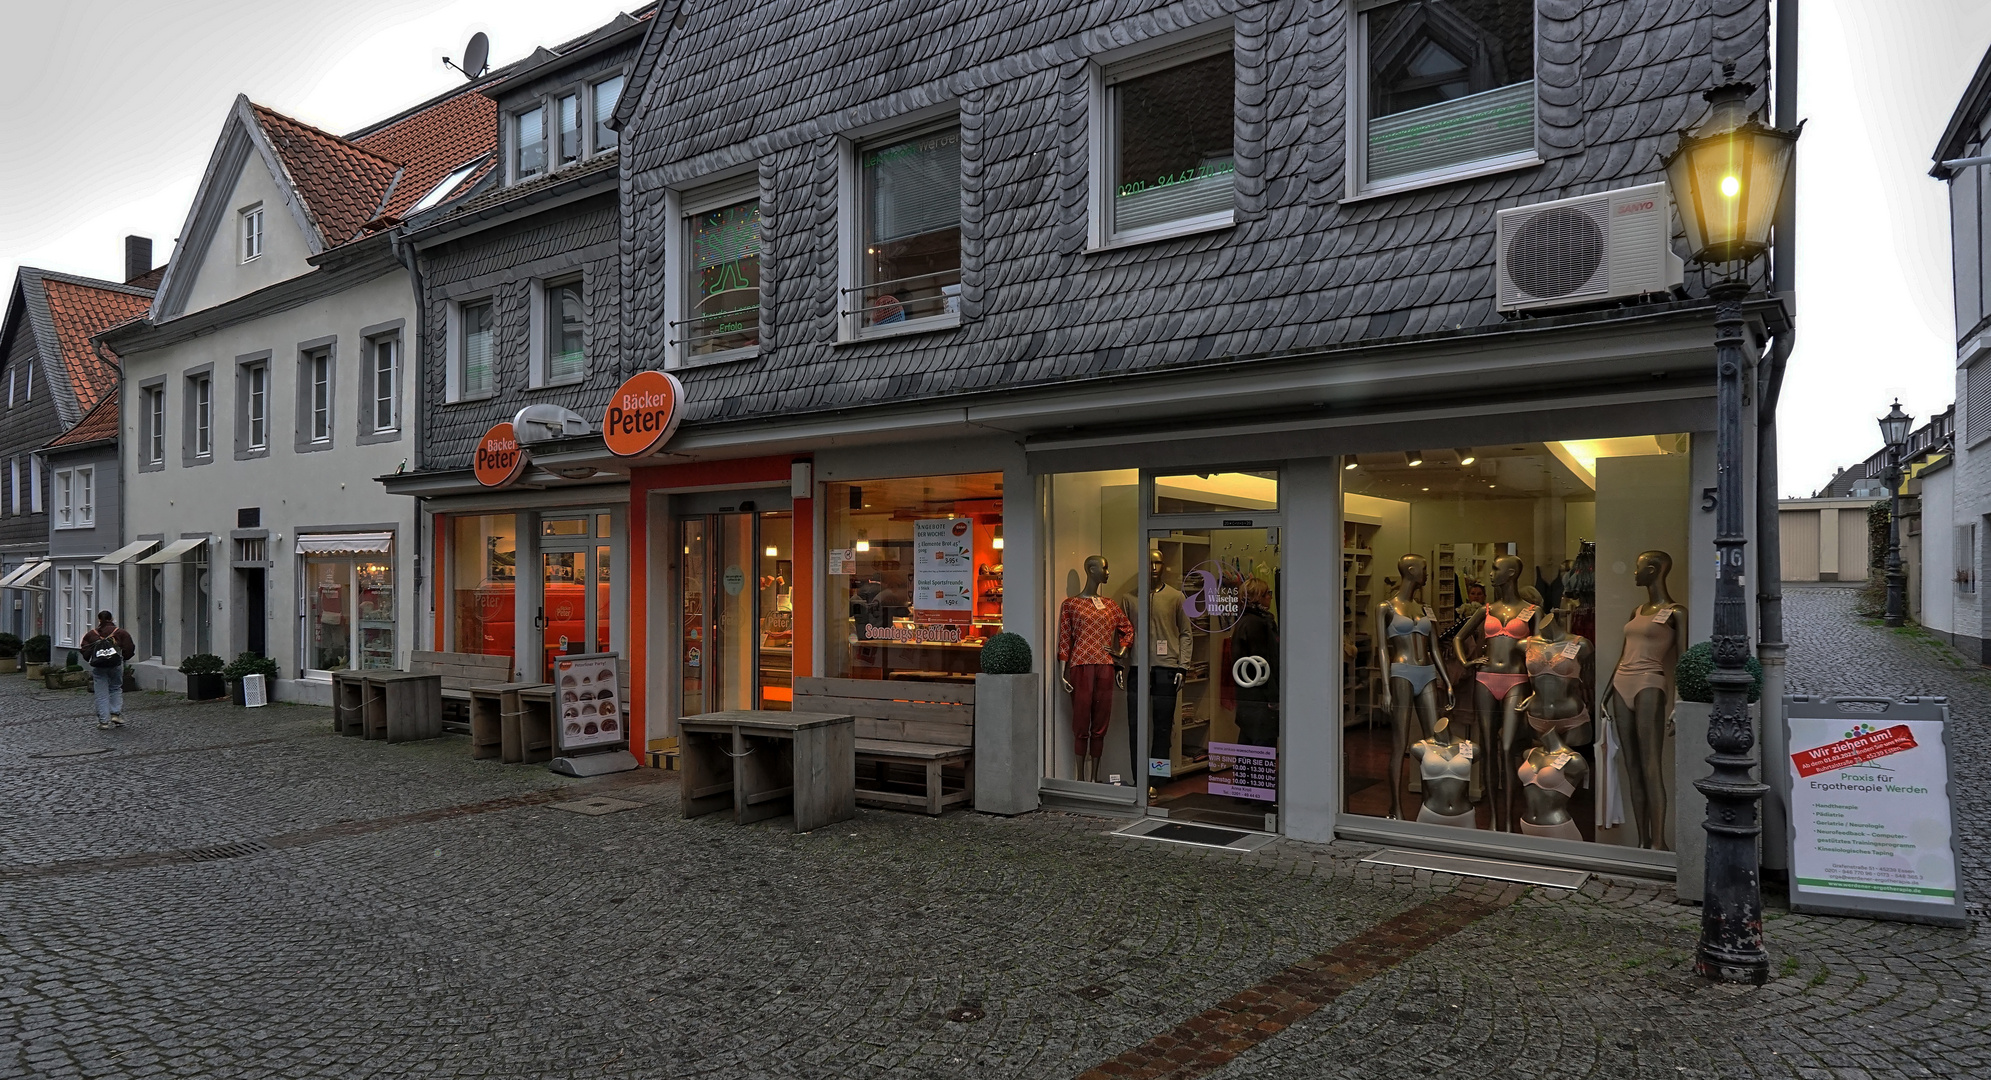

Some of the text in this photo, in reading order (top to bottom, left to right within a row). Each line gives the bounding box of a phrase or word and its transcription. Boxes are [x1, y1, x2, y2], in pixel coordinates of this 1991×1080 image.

[1117, 180, 1145, 197] 0201
[1158, 173, 1175, 188] 94
[1179, 169, 1194, 184] 67
[1198, 165, 1214, 179] 70
[1218, 160, 1234, 175] 96
[1617, 201, 1655, 215] SANYO
[623, 391, 667, 411] Bäcker
[609, 407, 665, 436] Peter
[487, 438, 516, 452] Bäcker
[478, 447, 516, 470] Peter
[1701, 487, 1718, 512] 5
[1721, 547, 1742, 567] 16
[1208, 587, 1239, 596] ANKAS
[474, 595, 500, 608] Peter
[1208, 594, 1239, 603] Wäsche
[1208, 602, 1239, 613] mode
[768, 616, 790, 628] Peter
[865, 623, 961, 644] Sonntags geöffnet
[1808, 729, 1893, 759] Wir ziehen um!
[1208, 754, 1221, 762] WIR
[1238, 757, 1251, 765] FÜR
[1264, 760, 1276, 768] DA:
[1208, 774, 1232, 785] Samstag
[1841, 773, 1894, 782] Praxis für
[1810, 781, 1928, 794] Ergotherapie Werden
[1815, 803, 1859, 811] Handtherapie
[1816, 811, 1845, 819] Pädiatrie
[1849, 822, 1885, 830] Neurologie
[1817, 829, 1865, 837] Neurofeedback
[1871, 832, 1908, 840] Computer-
[1817, 837, 1916, 849] gestütztes Trainingsprogramm
[1817, 846, 1894, 858] Kinesiologisches Taping
[1827, 881, 1922, 894] www.werdener-ergotherapie.de
